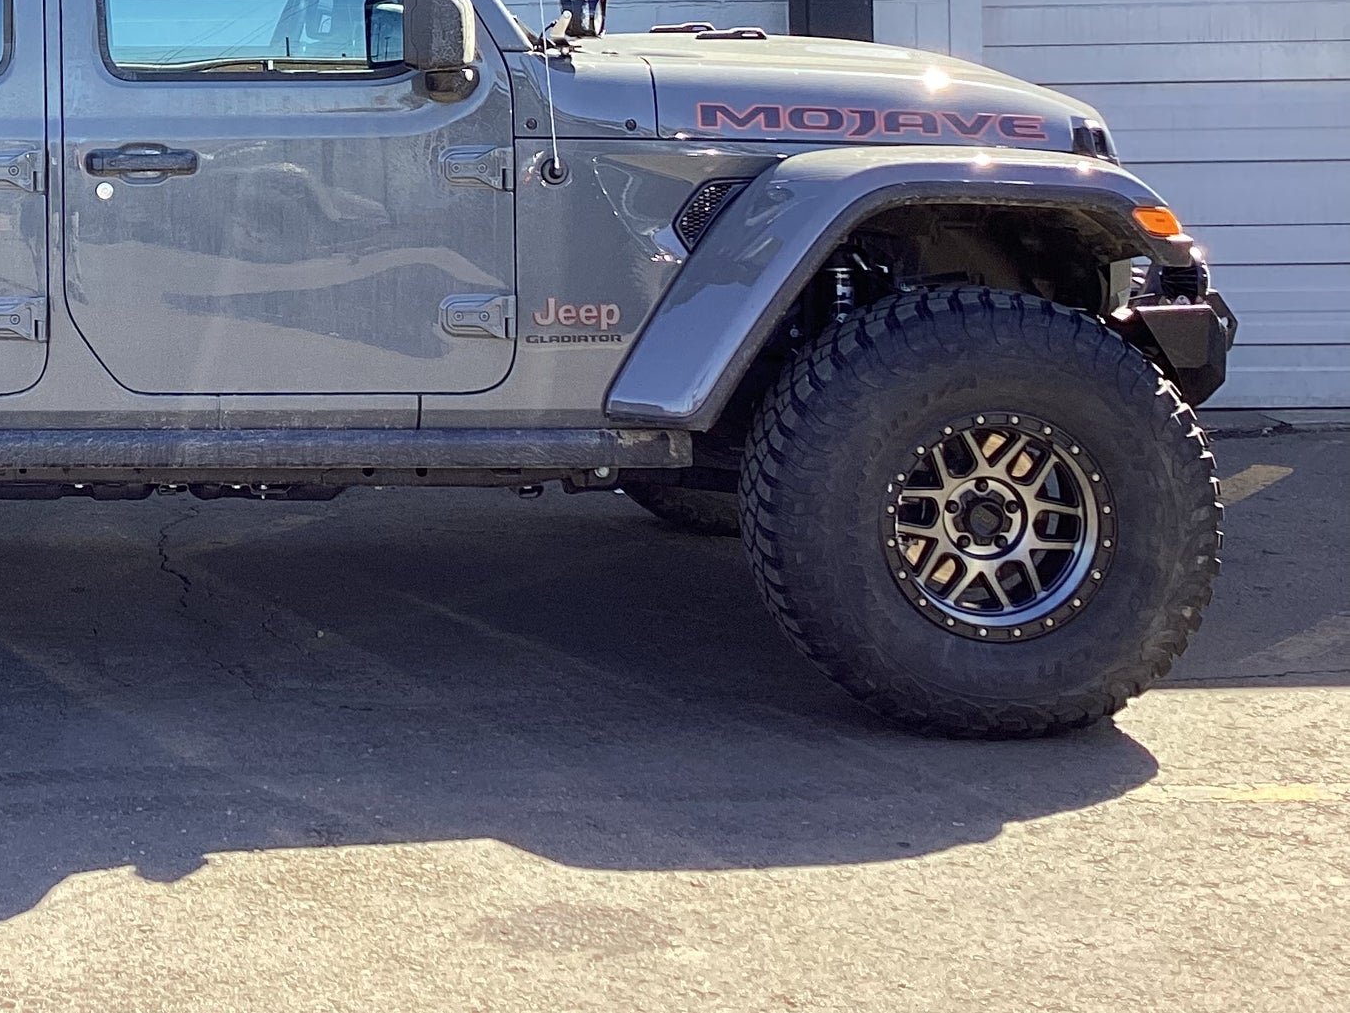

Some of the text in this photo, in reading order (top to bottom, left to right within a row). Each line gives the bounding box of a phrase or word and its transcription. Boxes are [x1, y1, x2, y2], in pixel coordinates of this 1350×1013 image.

[697, 101, 1048, 140] MOJAVE
[532, 297, 622, 331] Jeep
[525, 333, 623, 344] GLADIATOR
